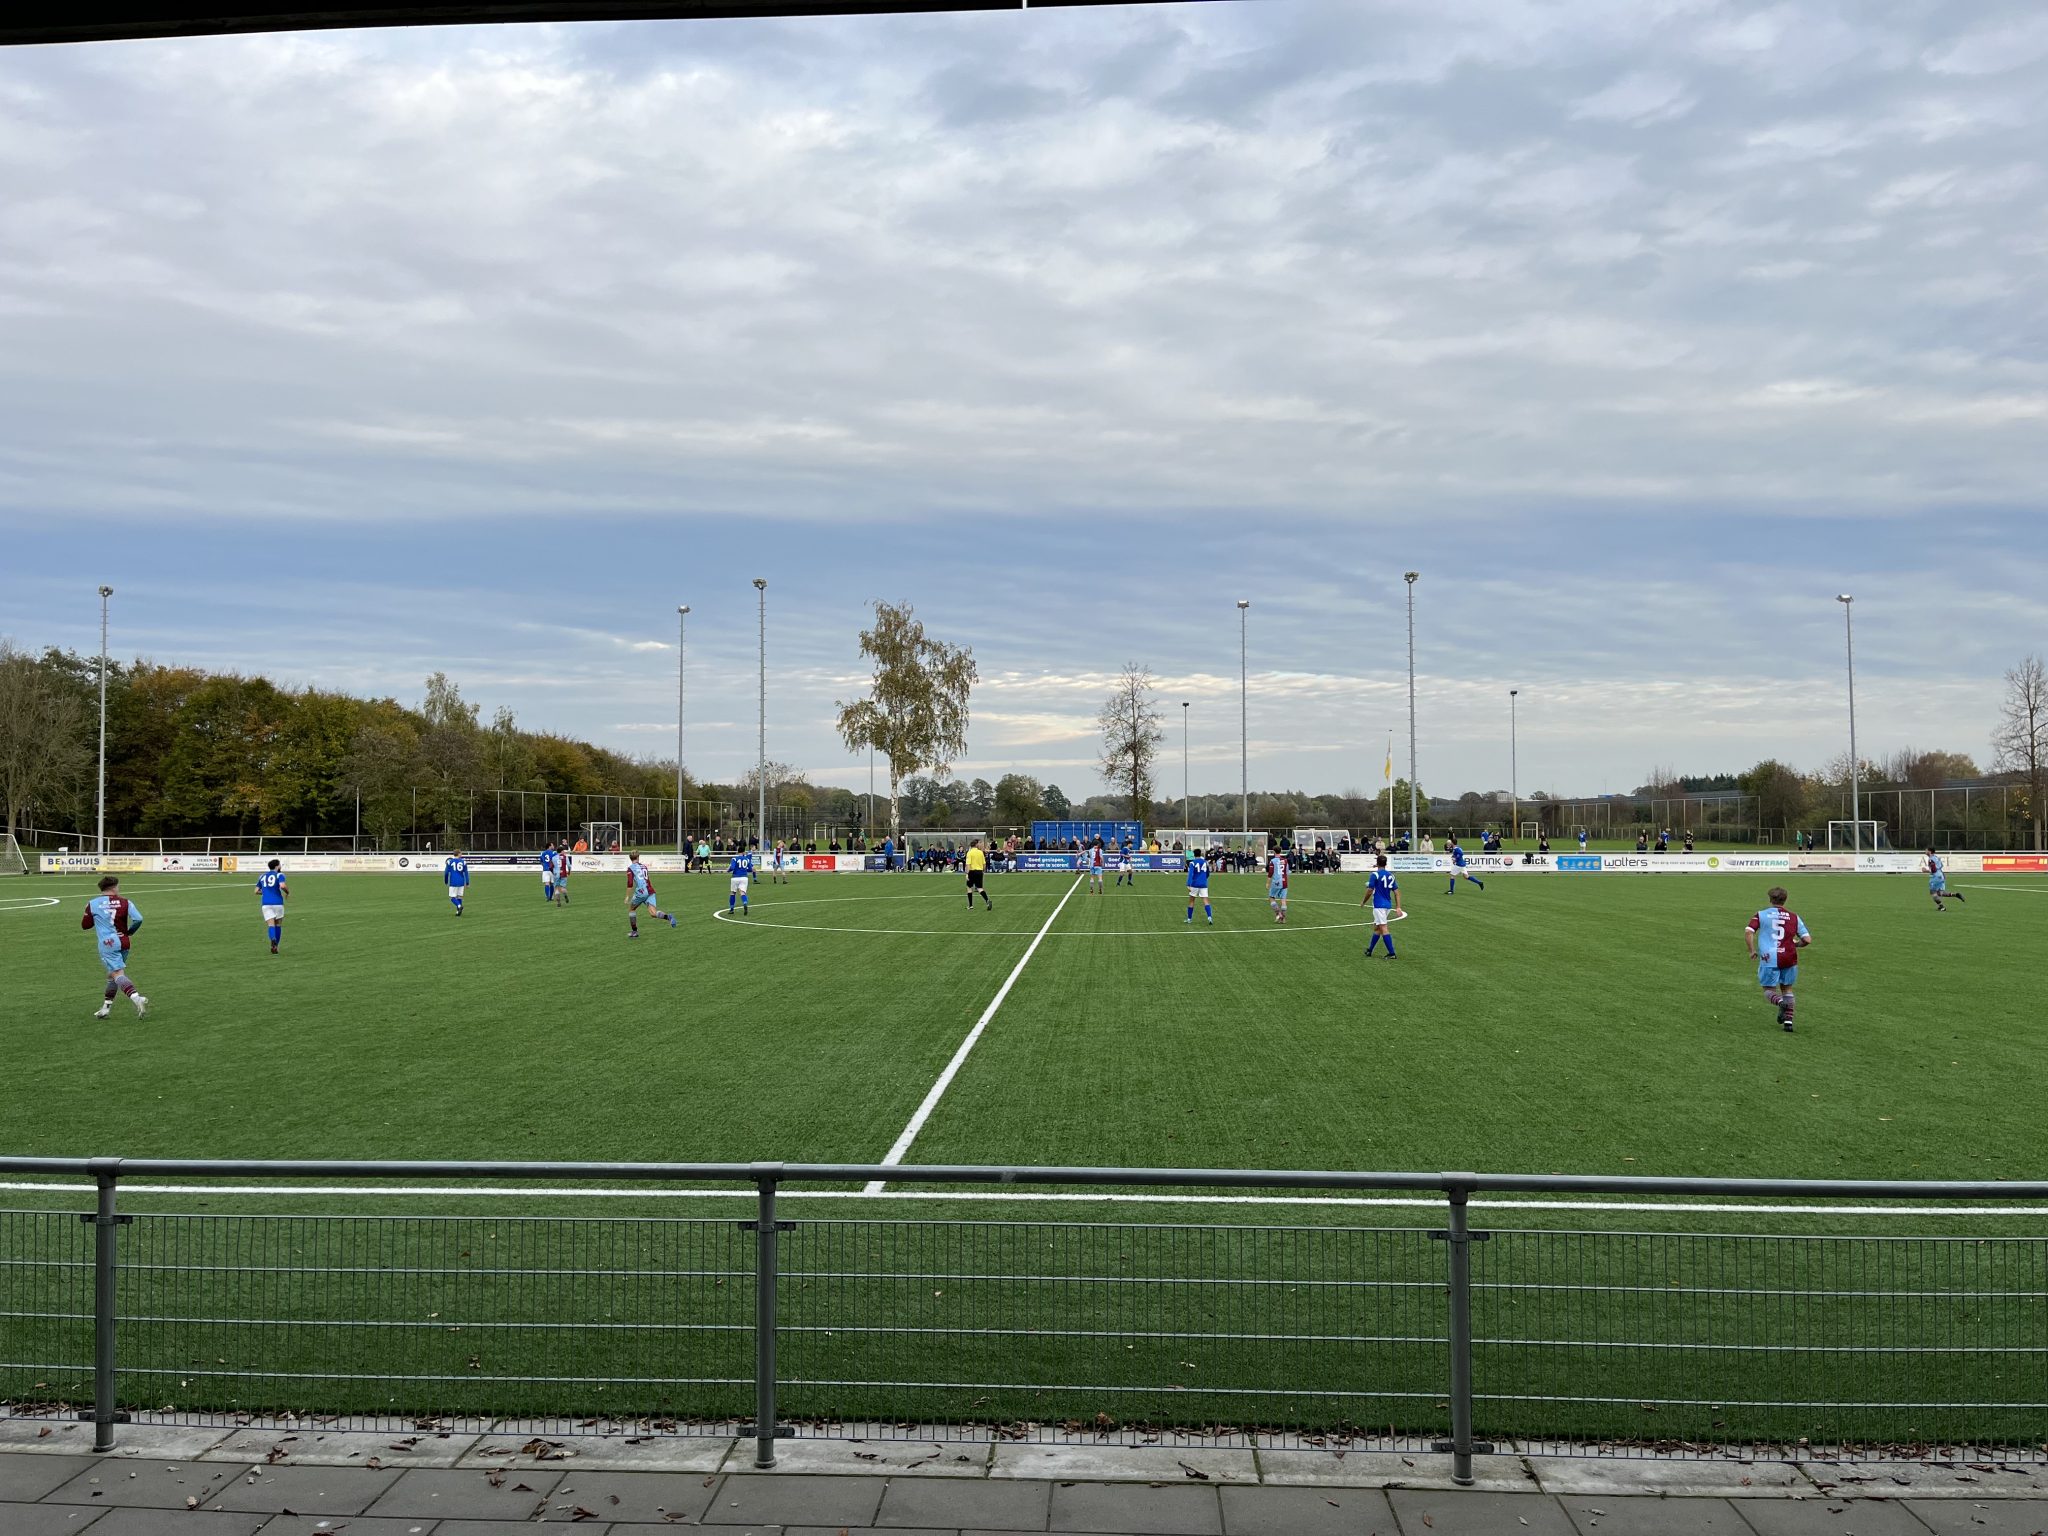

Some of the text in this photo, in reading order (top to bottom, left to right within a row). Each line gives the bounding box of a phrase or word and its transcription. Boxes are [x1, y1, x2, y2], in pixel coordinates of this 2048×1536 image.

[450, 861, 464, 872] 16
[736, 859, 749, 869] 10
[1194, 862, 1207, 873] 14
[1604, 857, 1648, 867] wolters
[260, 874, 276, 888] 19
[1380, 874, 1396, 889] 12
[104, 908, 117, 926] 7
[1771, 919, 1786, 941] 5
